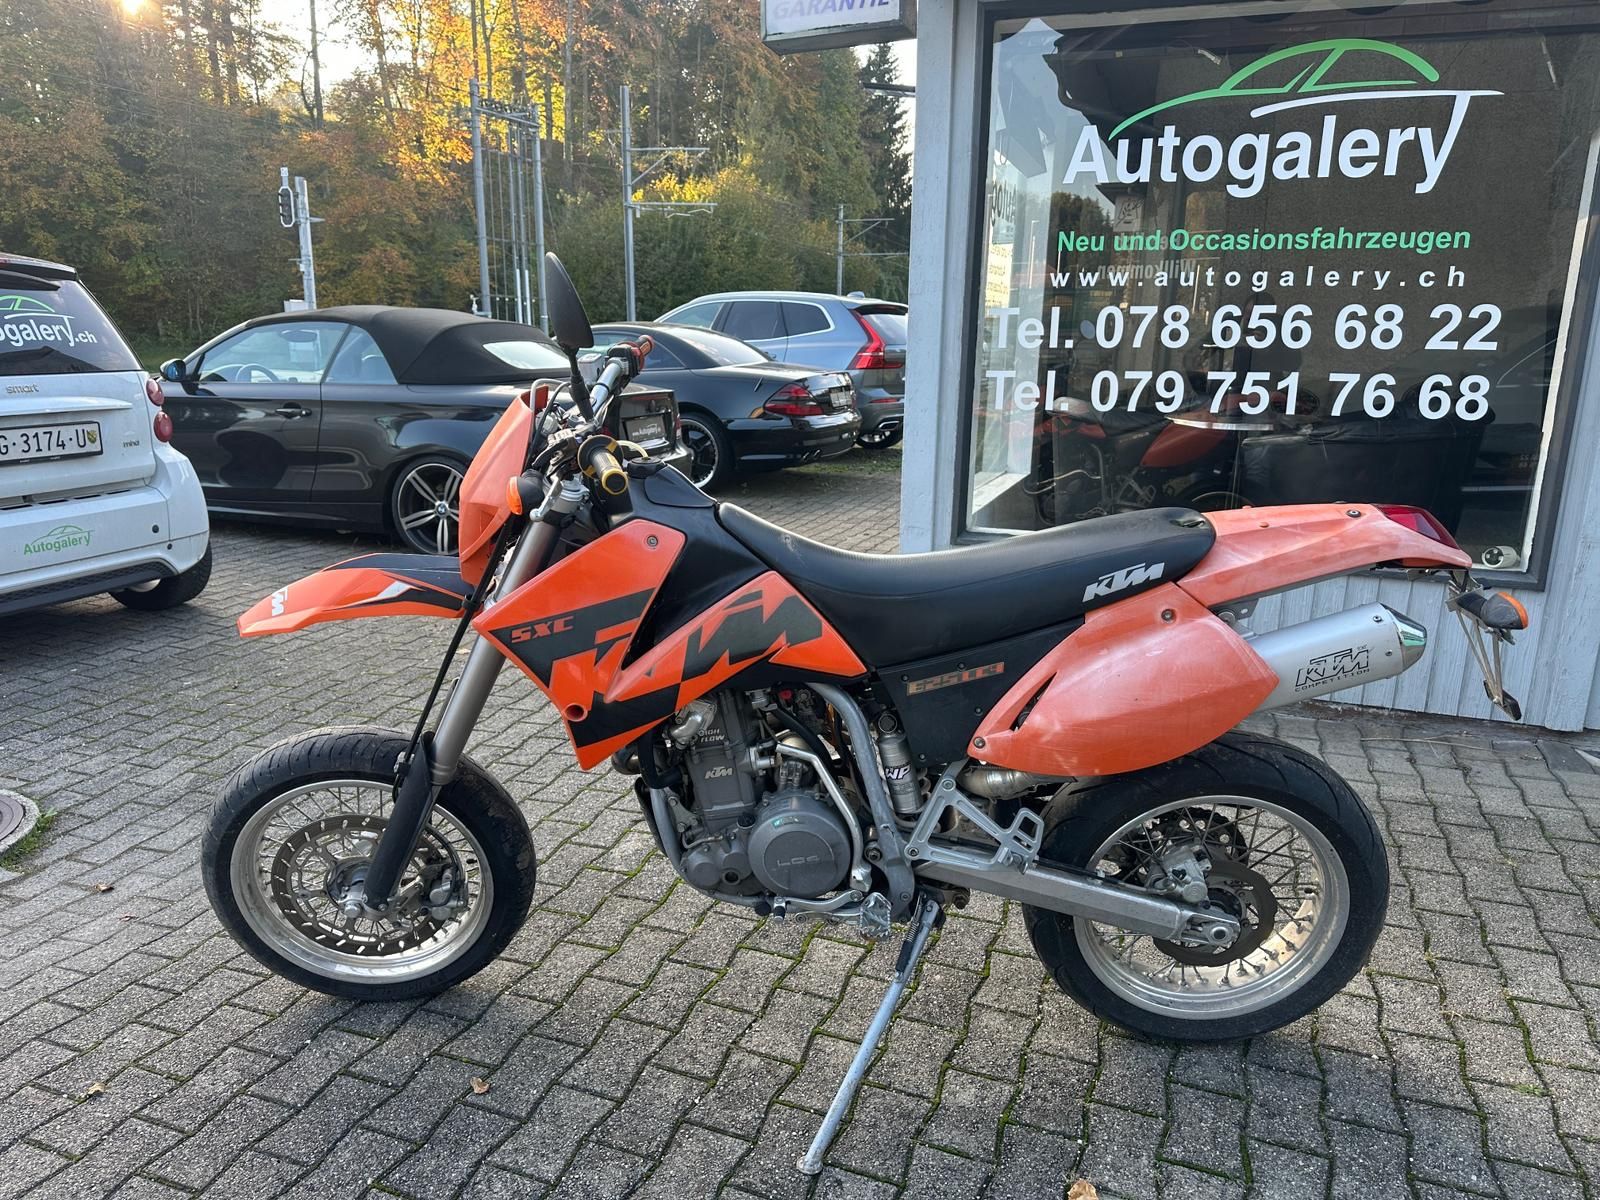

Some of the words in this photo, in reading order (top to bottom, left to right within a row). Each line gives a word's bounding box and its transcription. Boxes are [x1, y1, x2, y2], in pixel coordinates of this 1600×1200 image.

[773, 0, 889, 19] GARAN
[1062, 94, 1471, 197] Autogalery
[1058, 231, 1105, 252] Neu
[1113, 230, 1161, 251] und
[1169, 227, 1471, 254] Occasionsfahrzeugen
[988, 306, 1074, 349] Tel.
[1095, 304, 1191, 349] 078
[1211, 303, 1313, 349] 656
[1334, 303, 1404, 350] 68
[1424, 303, 1502, 351] 22
[6, 383, 40, 394] smart
[985, 370, 1070, 412] Tel.
[1090, 370, 1185, 413] 079
[1206, 371, 1300, 416] 751
[1328, 372, 1397, 418] 76
[1418, 374, 1490, 421] 68
[23, 531, 91, 555] Autogalery
[1082, 562, 1165, 603] KTM
[511, 615, 574, 644] SXC
[1294, 668, 1370, 692] COMPETITION
[1295, 648, 1369, 687] KTM
[704, 766, 733, 779] KTM
[885, 764, 911, 780] WP
